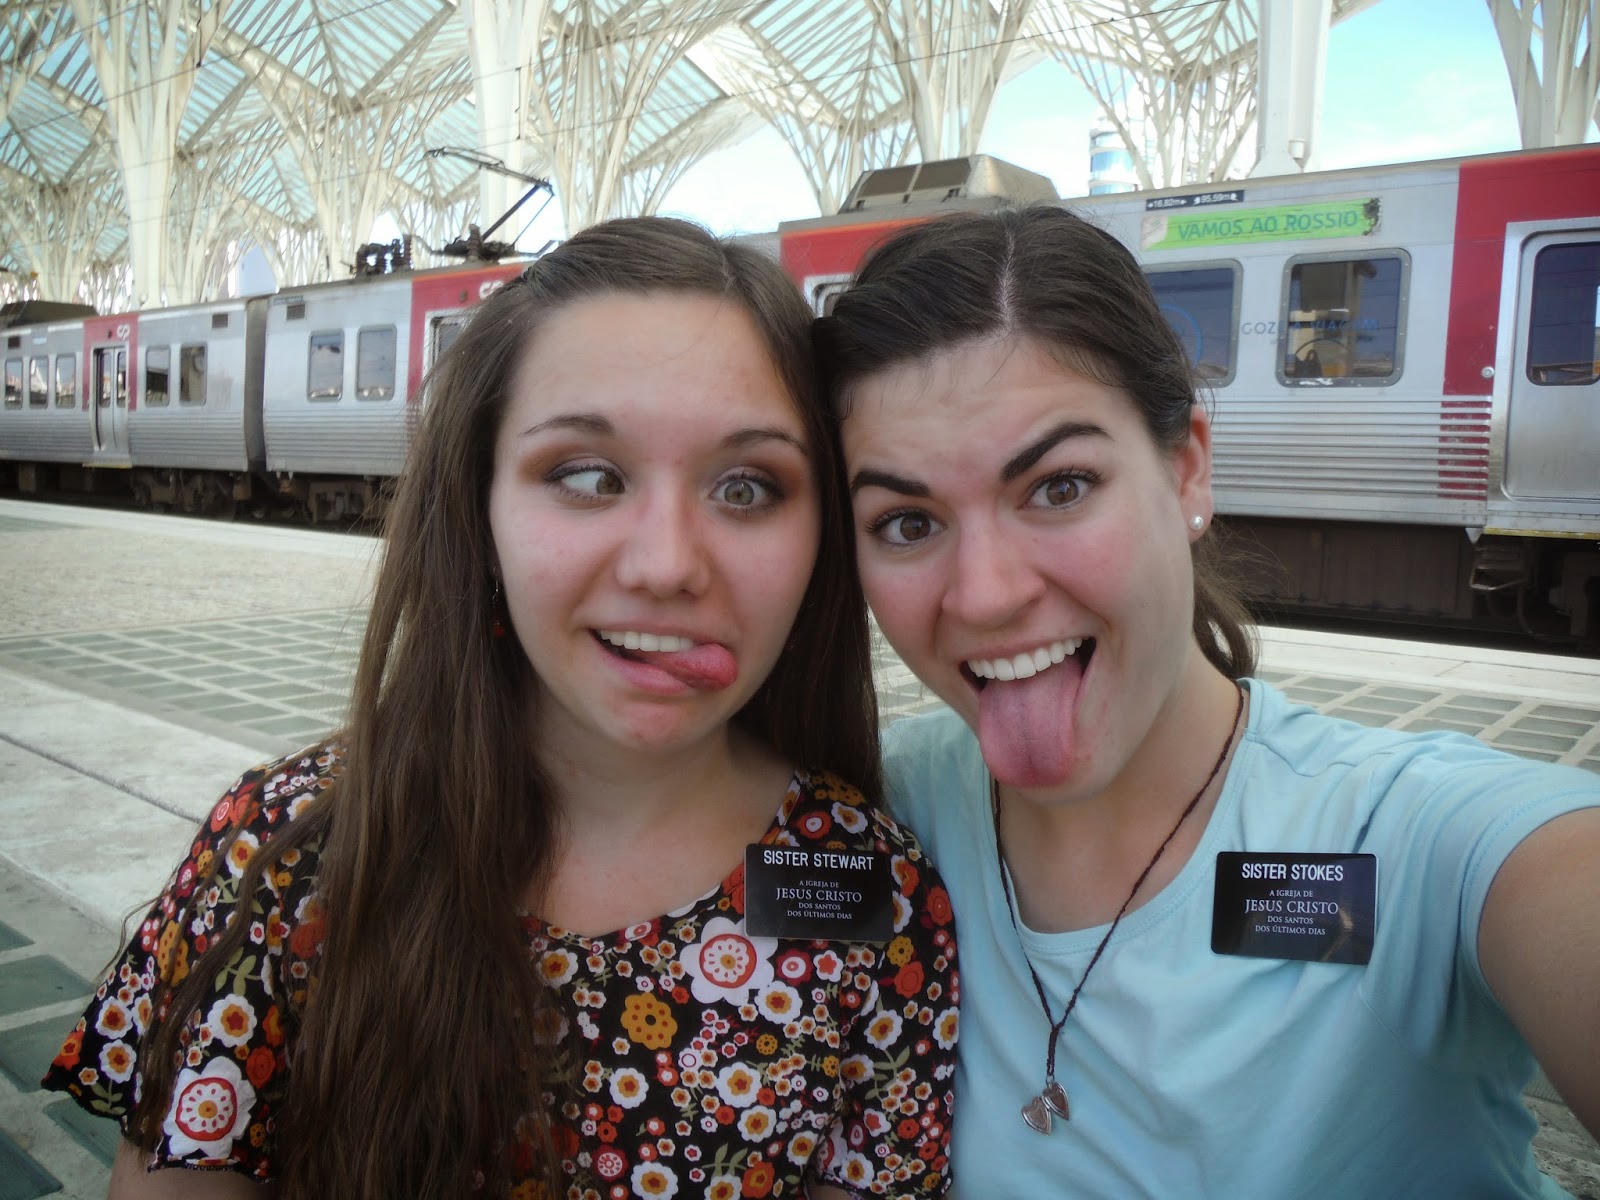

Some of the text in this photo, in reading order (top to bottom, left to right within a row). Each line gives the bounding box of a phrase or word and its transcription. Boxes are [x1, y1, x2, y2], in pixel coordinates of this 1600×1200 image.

[1178, 219, 1243, 240] VAMOS
[1250, 215, 1278, 233] AO
[1284, 210, 1359, 232] ROSSIO
[763, 849, 875, 871] SISTER STEWART
[1241, 862, 1344, 881] SISTER STOKES
[805, 880, 829, 888] IGREJA
[776, 887, 862, 903] JESUS CRISTO
[1276, 890, 1301, 898] IGREJA
[1303, 890, 1314, 898] DE
[814, 903, 841, 911] SANTOS
[1245, 899, 1339, 915] JESUS CRISTO
[803, 909, 835, 919] ÚLTIMOS
[836, 912, 852, 920] DIAS
[1267, 915, 1314, 924] DOS SANTOS
[1272, 925, 1306, 935] ÚLTIMOS
[1308, 927, 1326, 936] DIAS
